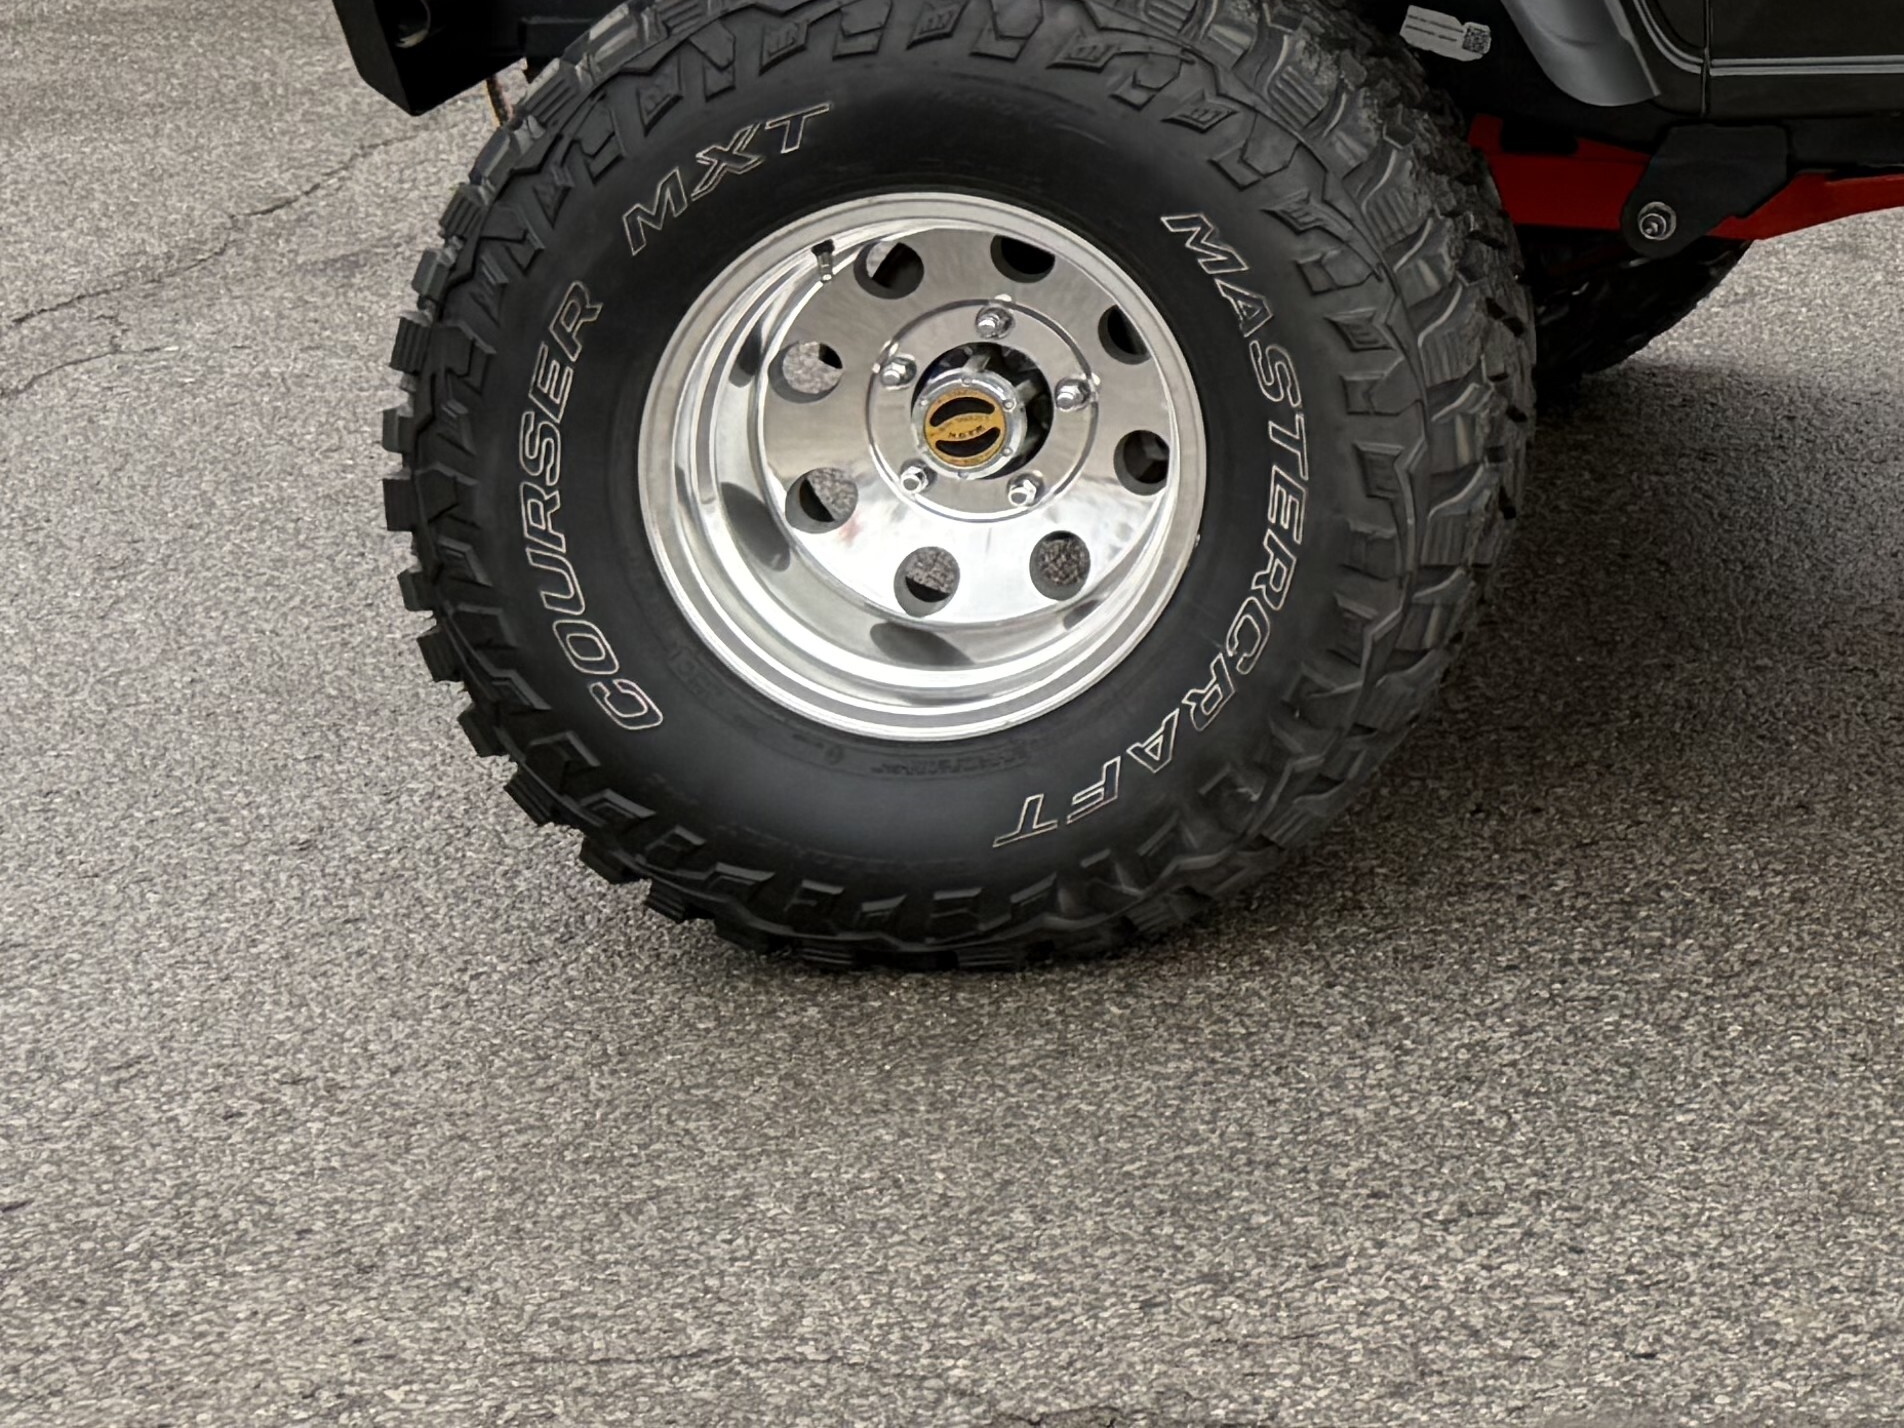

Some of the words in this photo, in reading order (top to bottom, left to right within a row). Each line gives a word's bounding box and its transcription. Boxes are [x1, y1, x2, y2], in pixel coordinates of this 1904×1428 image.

[621, 103, 831, 256] MXT
[519, 280, 663, 731] COURSER
[992, 211, 1310, 848] MASTERCRAFT
